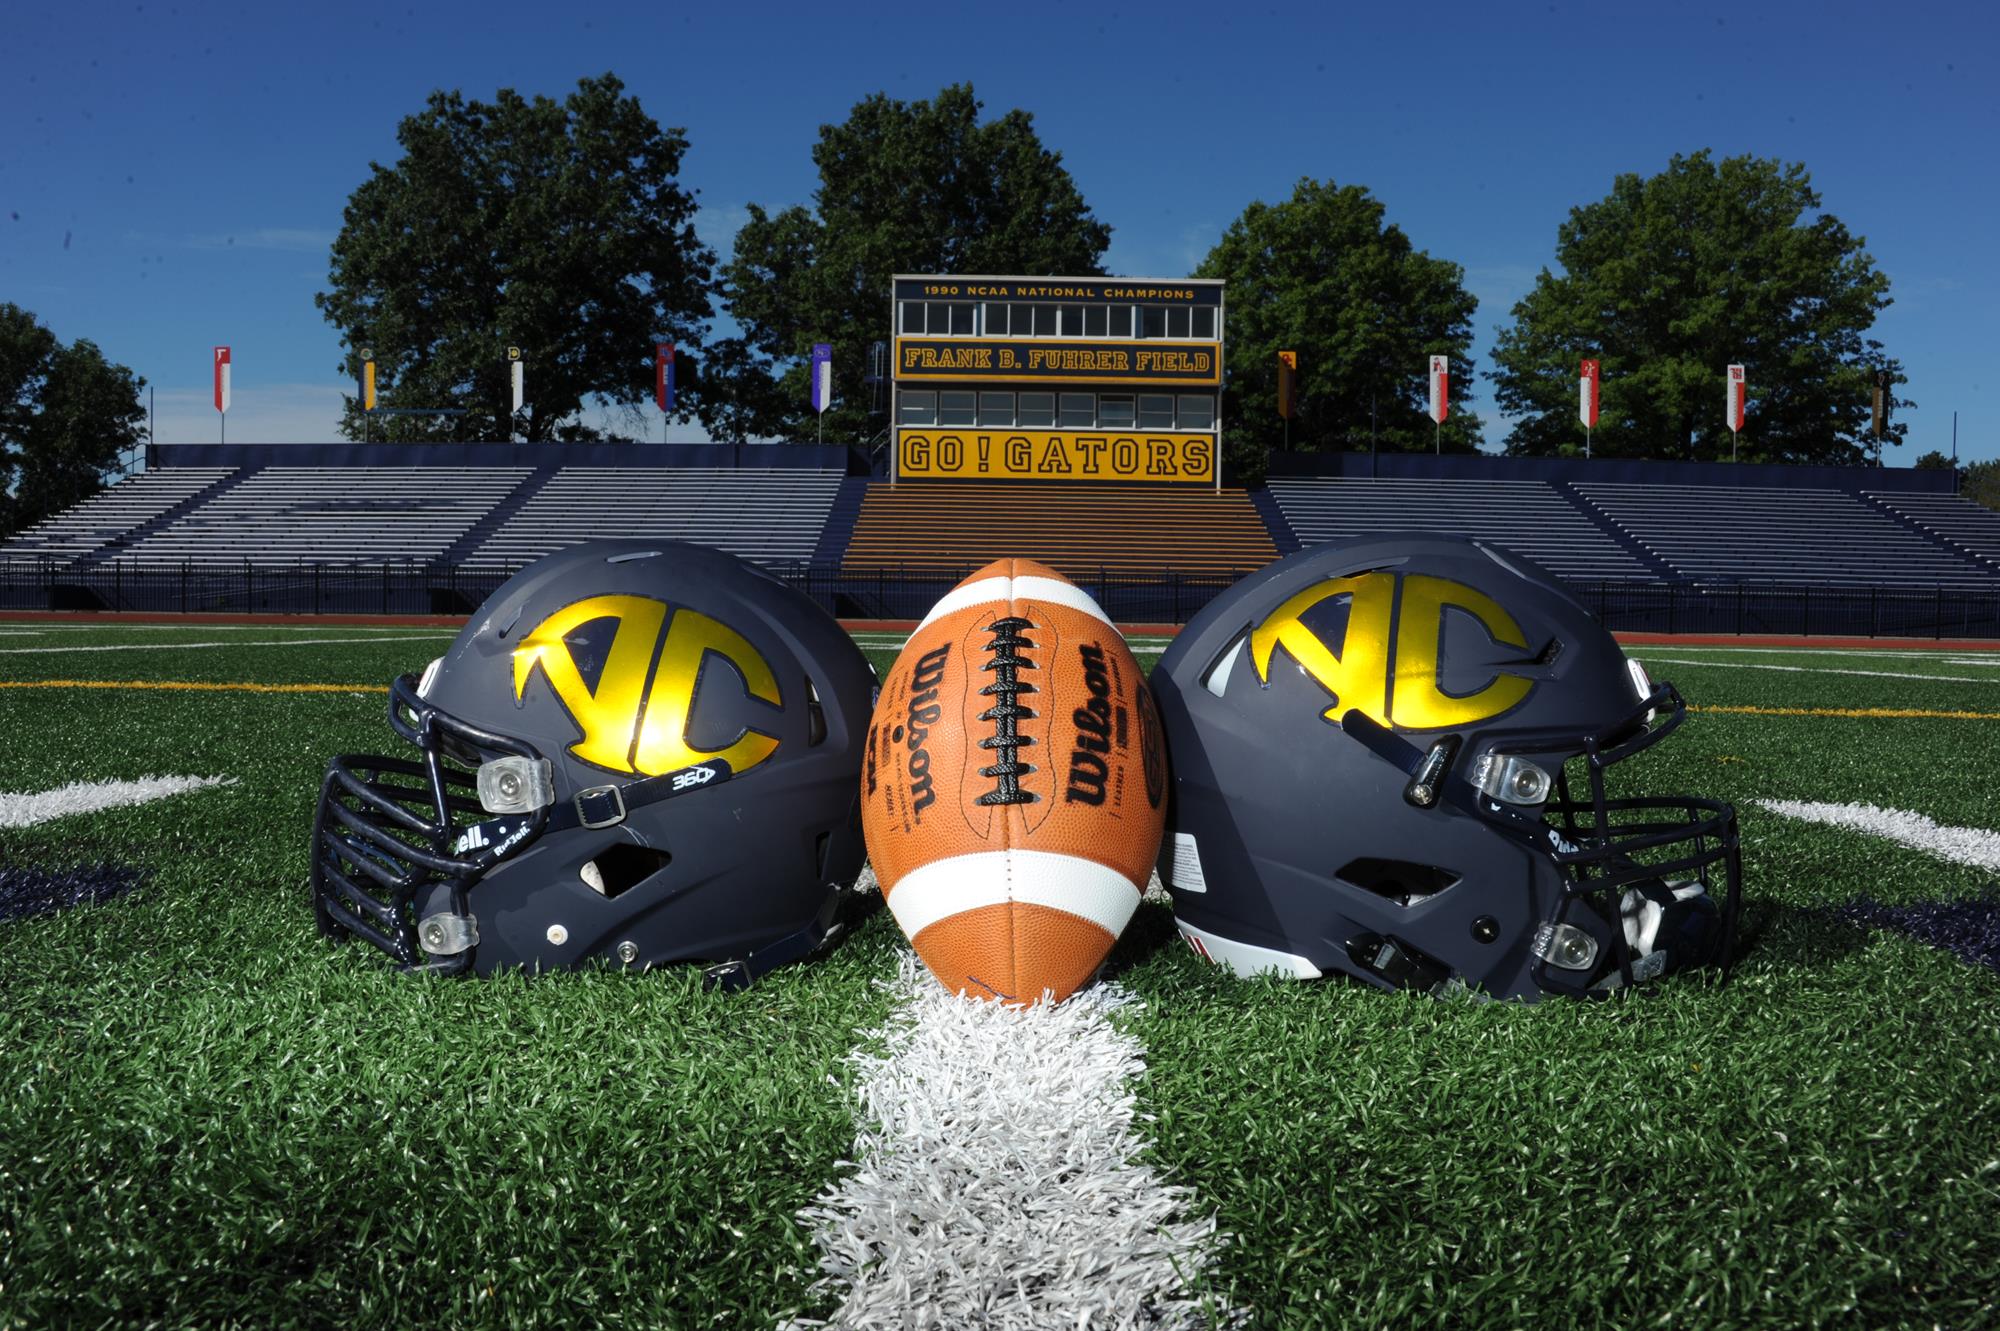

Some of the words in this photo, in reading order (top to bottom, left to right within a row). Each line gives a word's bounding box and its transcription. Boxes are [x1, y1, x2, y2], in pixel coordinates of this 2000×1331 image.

[924, 286, 959, 295] 1990
[967, 286, 1008, 296] NCAA
[1017, 287, 1096, 298] NATIONAL
[1104, 288, 1195, 299] CHAMPIONS
[905, 348, 992, 368] FRANK
[999, 349, 1022, 369] B.
[1028, 349, 1129, 371] FUHRER
[1136, 351, 1210, 372] FIELD
[907, 642, 953, 818] Wilson
[1065, 641, 1110, 807] Wilson
